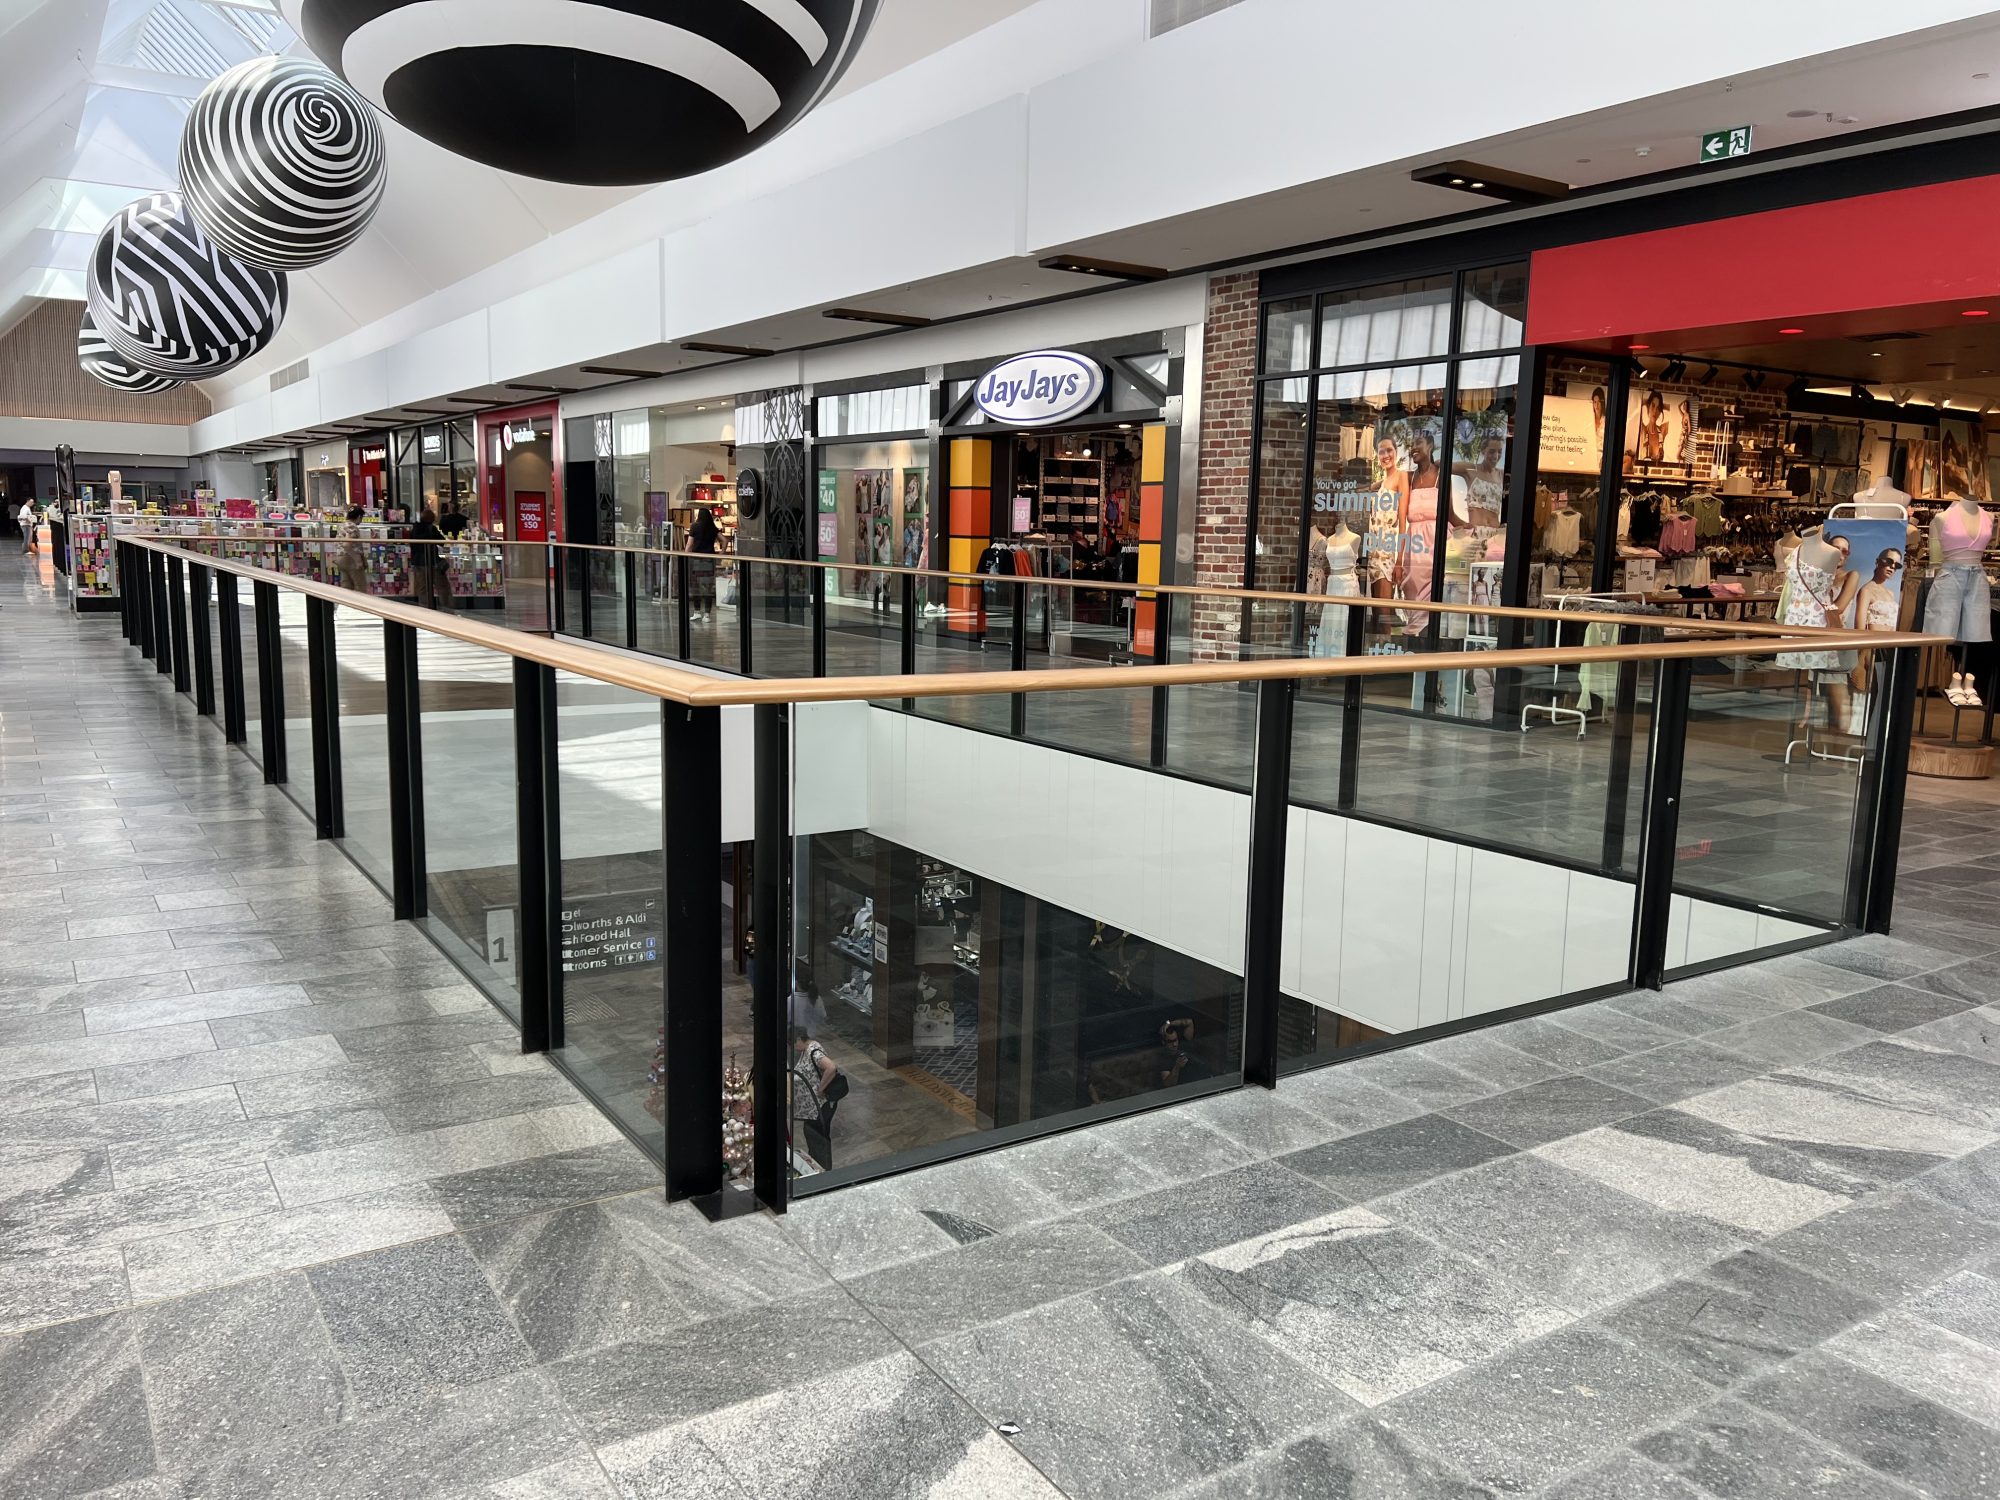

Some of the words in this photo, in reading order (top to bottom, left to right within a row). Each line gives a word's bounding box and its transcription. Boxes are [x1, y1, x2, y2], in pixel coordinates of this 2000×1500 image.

[981, 369, 1079, 407] JayJays
[1316, 479, 1342, 490] You've
[1343, 479, 1357, 491] got
[1314, 491, 1402, 512] summer
[523, 521, 539, 529] $50
[1362, 527, 1430, 557] plans.
[615, 915, 624, 926] &
[625, 912, 647, 924] Aldi
[580, 930, 608, 944] Food
[610, 927, 631, 939] Hall
[492, 936, 509, 963] 1
[603, 940, 642, 954] Service
